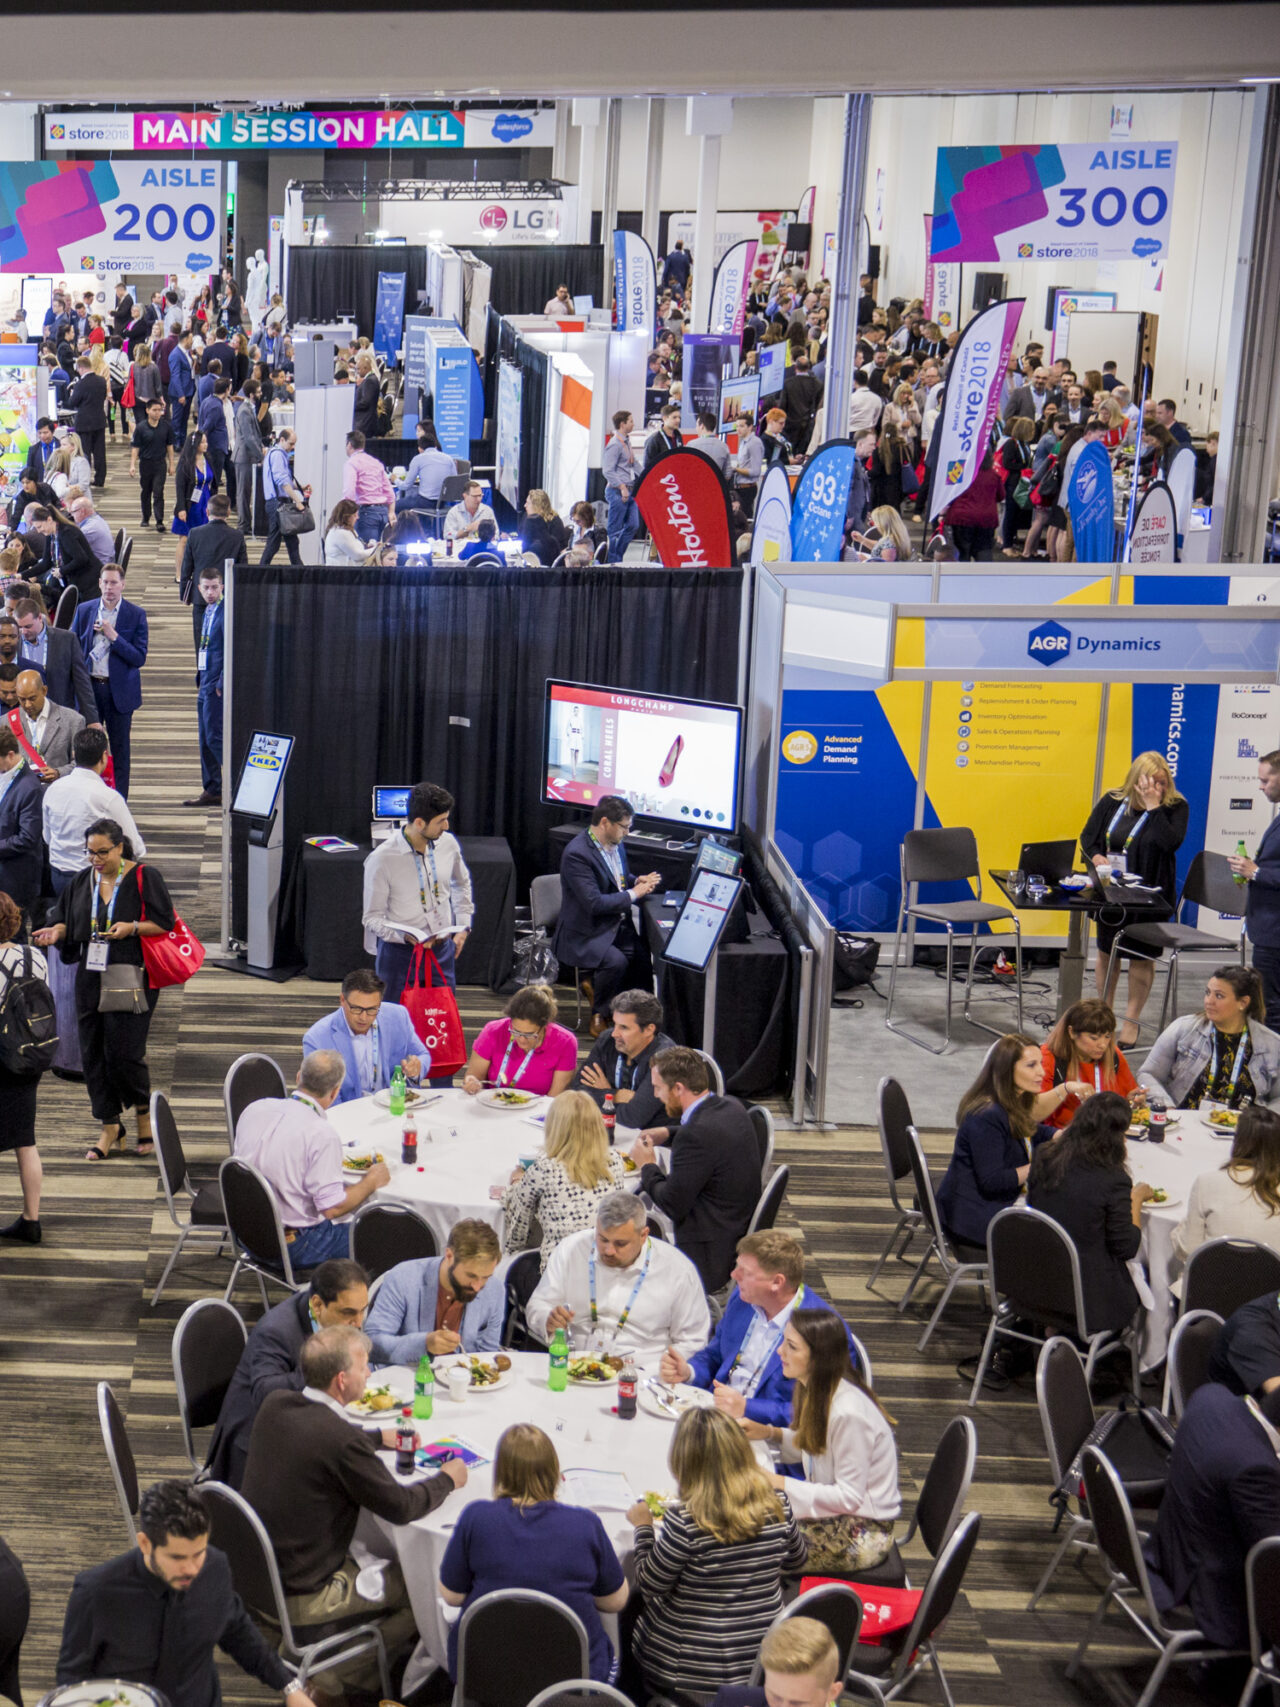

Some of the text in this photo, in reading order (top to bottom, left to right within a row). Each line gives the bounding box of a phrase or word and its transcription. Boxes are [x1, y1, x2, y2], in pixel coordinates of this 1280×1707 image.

[142, 116, 457, 144] MAIN SESSION HALL
[496, 121, 531, 132] salesforce
[69, 129, 129, 141] store2018
[1088, 149, 1172, 170] AISLE
[140, 167, 216, 187] AISLE
[1055, 186, 1168, 228] 300
[113, 203, 216, 242] 200
[513, 210, 544, 229] LG
[1036, 246, 1099, 258] store2018
[98, 260, 155, 271] store2018
[958, 340, 992, 452] store2018
[811, 471, 837, 506] 93
[808, 502, 832, 519] Octane
[1028, 634, 1162, 655] AGR Dynamics
[1007, 682, 1044, 691] Forecasting
[610, 695, 675, 712] LONGCHAMP
[978, 698, 1025, 706] Replenishment
[977, 713, 1008, 721] Inventory
[998, 728, 1033, 736] Operations
[824, 735, 863, 744] Advanced
[603, 717, 615, 778] CORAL HEELS
[823, 745, 858, 754] Demand
[1008, 744, 1050, 752] Management
[251, 757, 278, 768] IKEA
[822, 755, 858, 765] Planning
[1013, 759, 1042, 768] Planning
